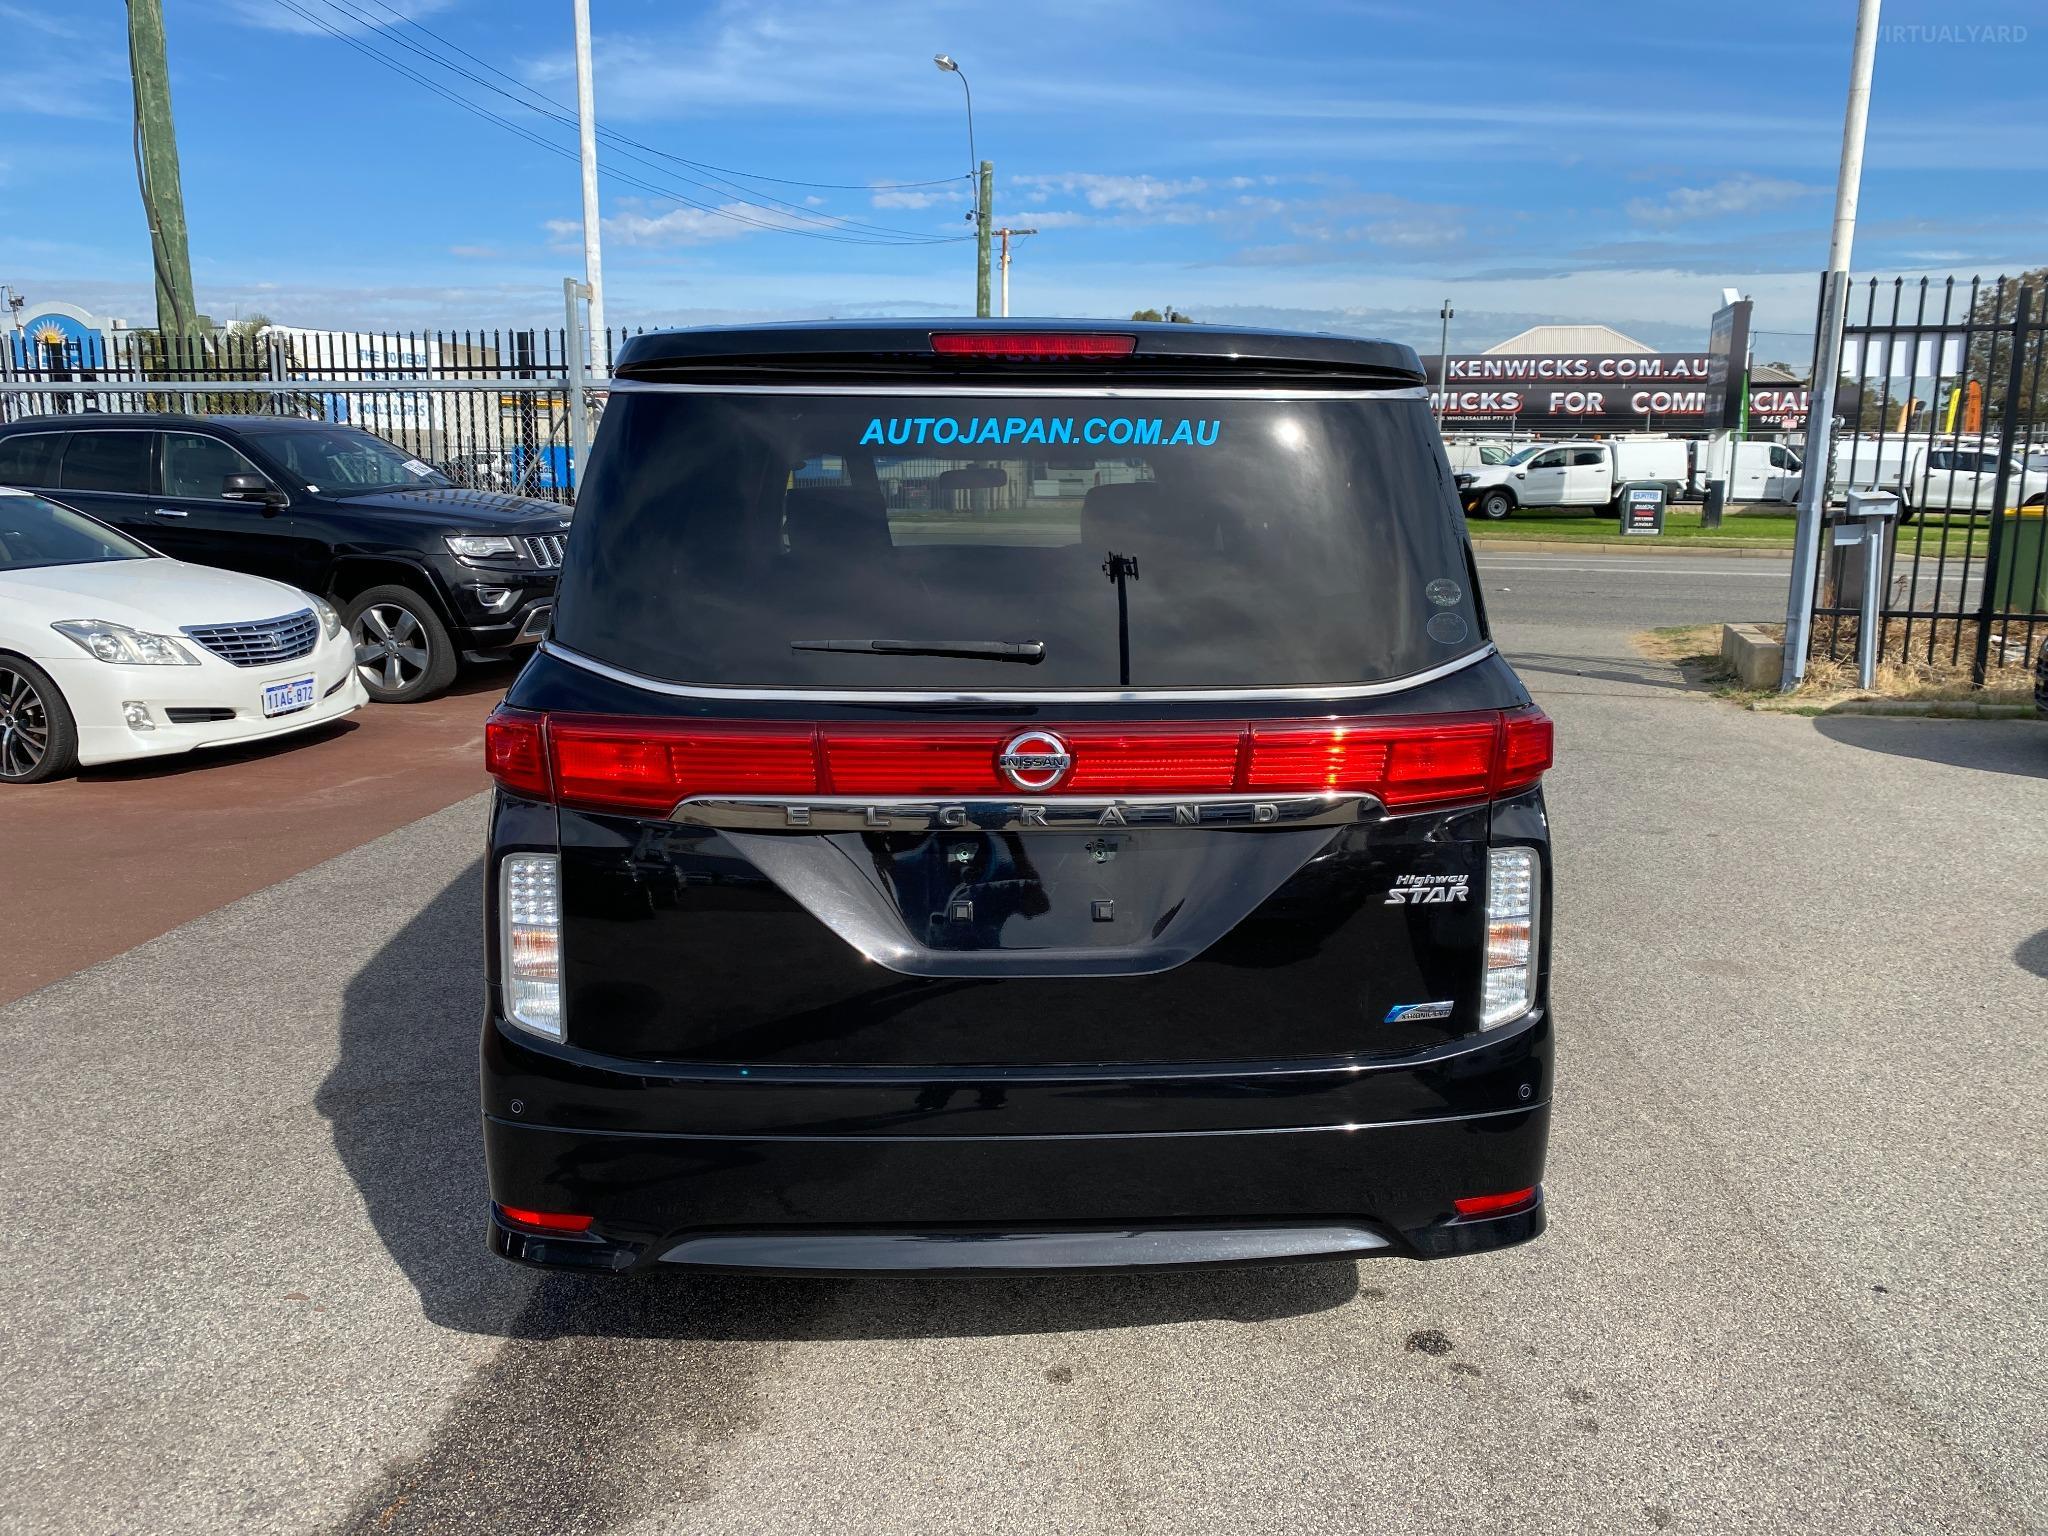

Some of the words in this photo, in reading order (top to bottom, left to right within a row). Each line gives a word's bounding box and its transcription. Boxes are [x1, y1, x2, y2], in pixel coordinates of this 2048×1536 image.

[1450, 359, 1709, 379] KENWICKS.COM.AU
[401, 404, 426, 416] SPS
[1550, 392, 1604, 412] FOR
[860, 417, 1220, 446] AUTOJAPAN.COM.AU
[1007, 756, 1064, 768] NISSAN
[785, 805, 1281, 827] ELGRAND
[1395, 874, 1470, 888] Highway
[1383, 885, 1470, 905] STAR
